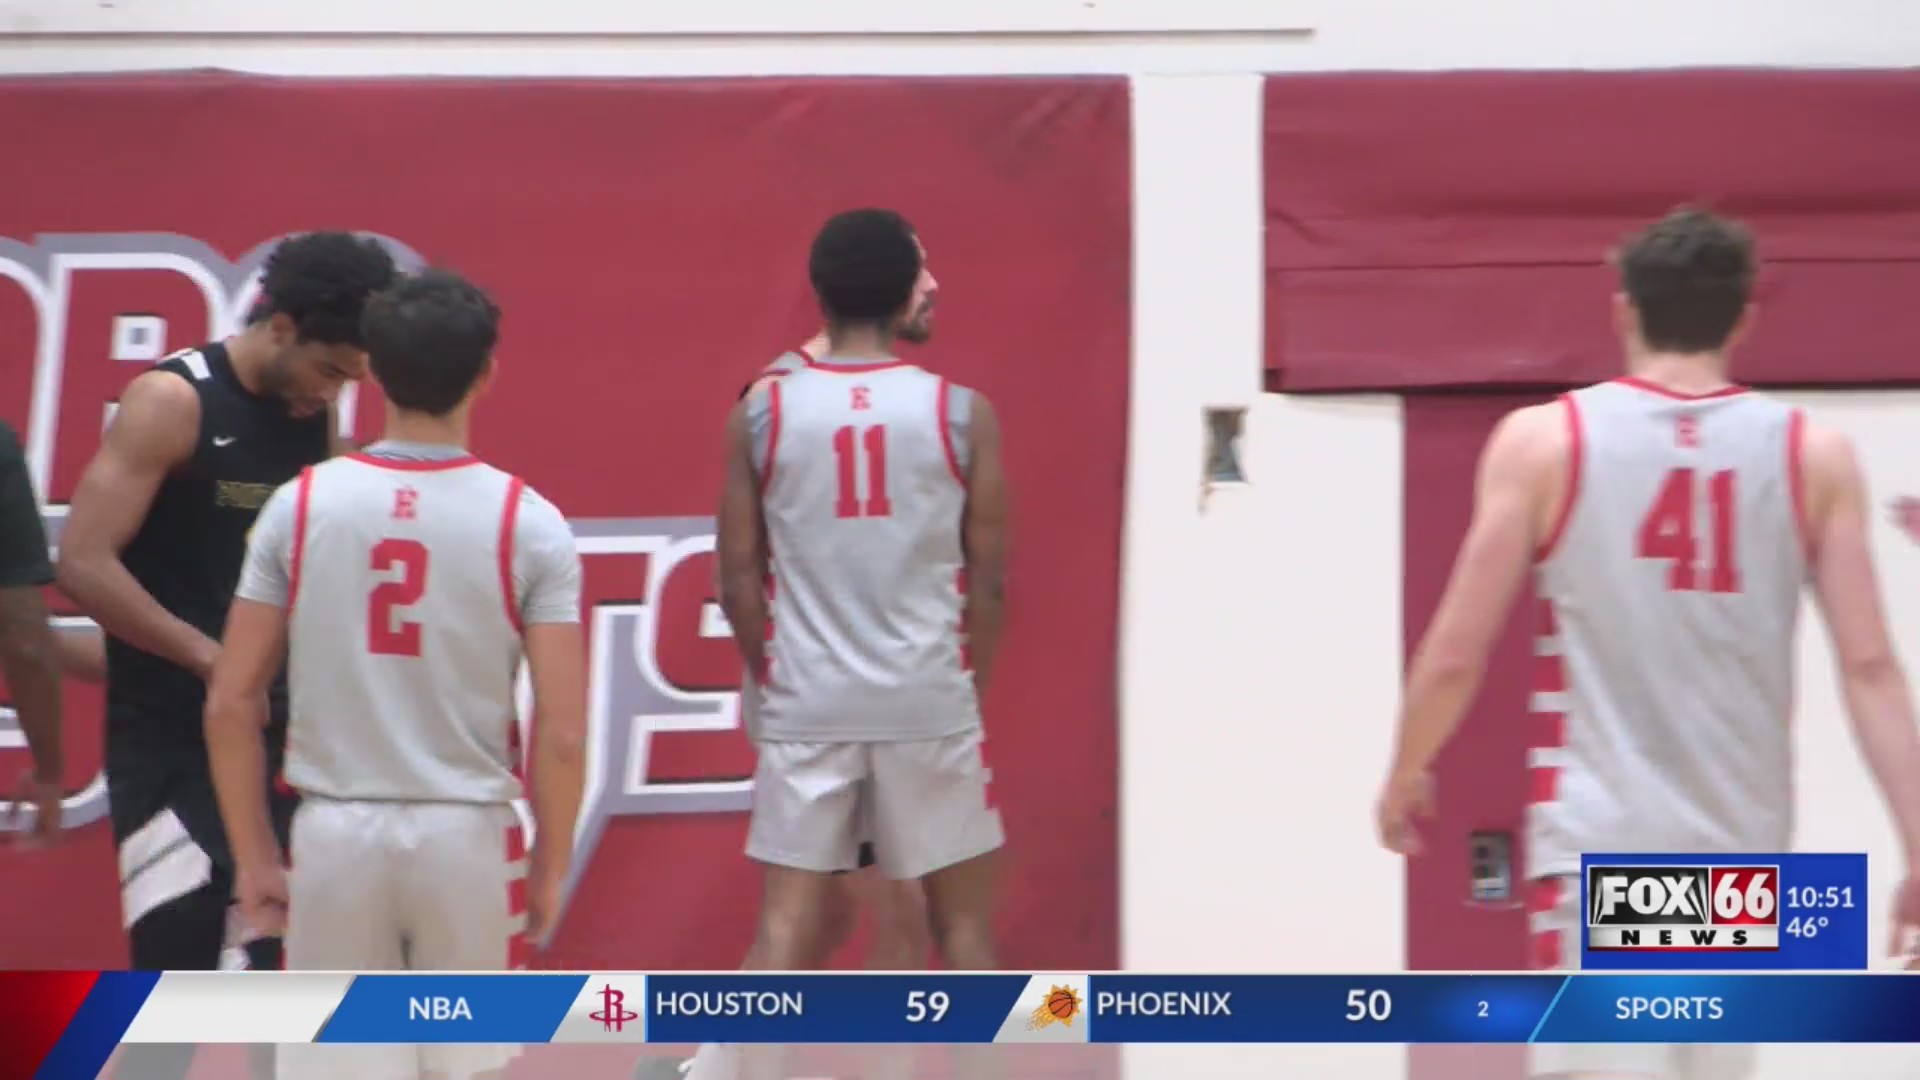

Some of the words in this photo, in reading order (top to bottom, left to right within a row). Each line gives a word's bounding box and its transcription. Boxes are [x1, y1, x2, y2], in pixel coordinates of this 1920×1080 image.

[832, 424, 892, 519] 11
[1635, 467, 1742, 594] 41
[367, 538, 428, 657] 2
